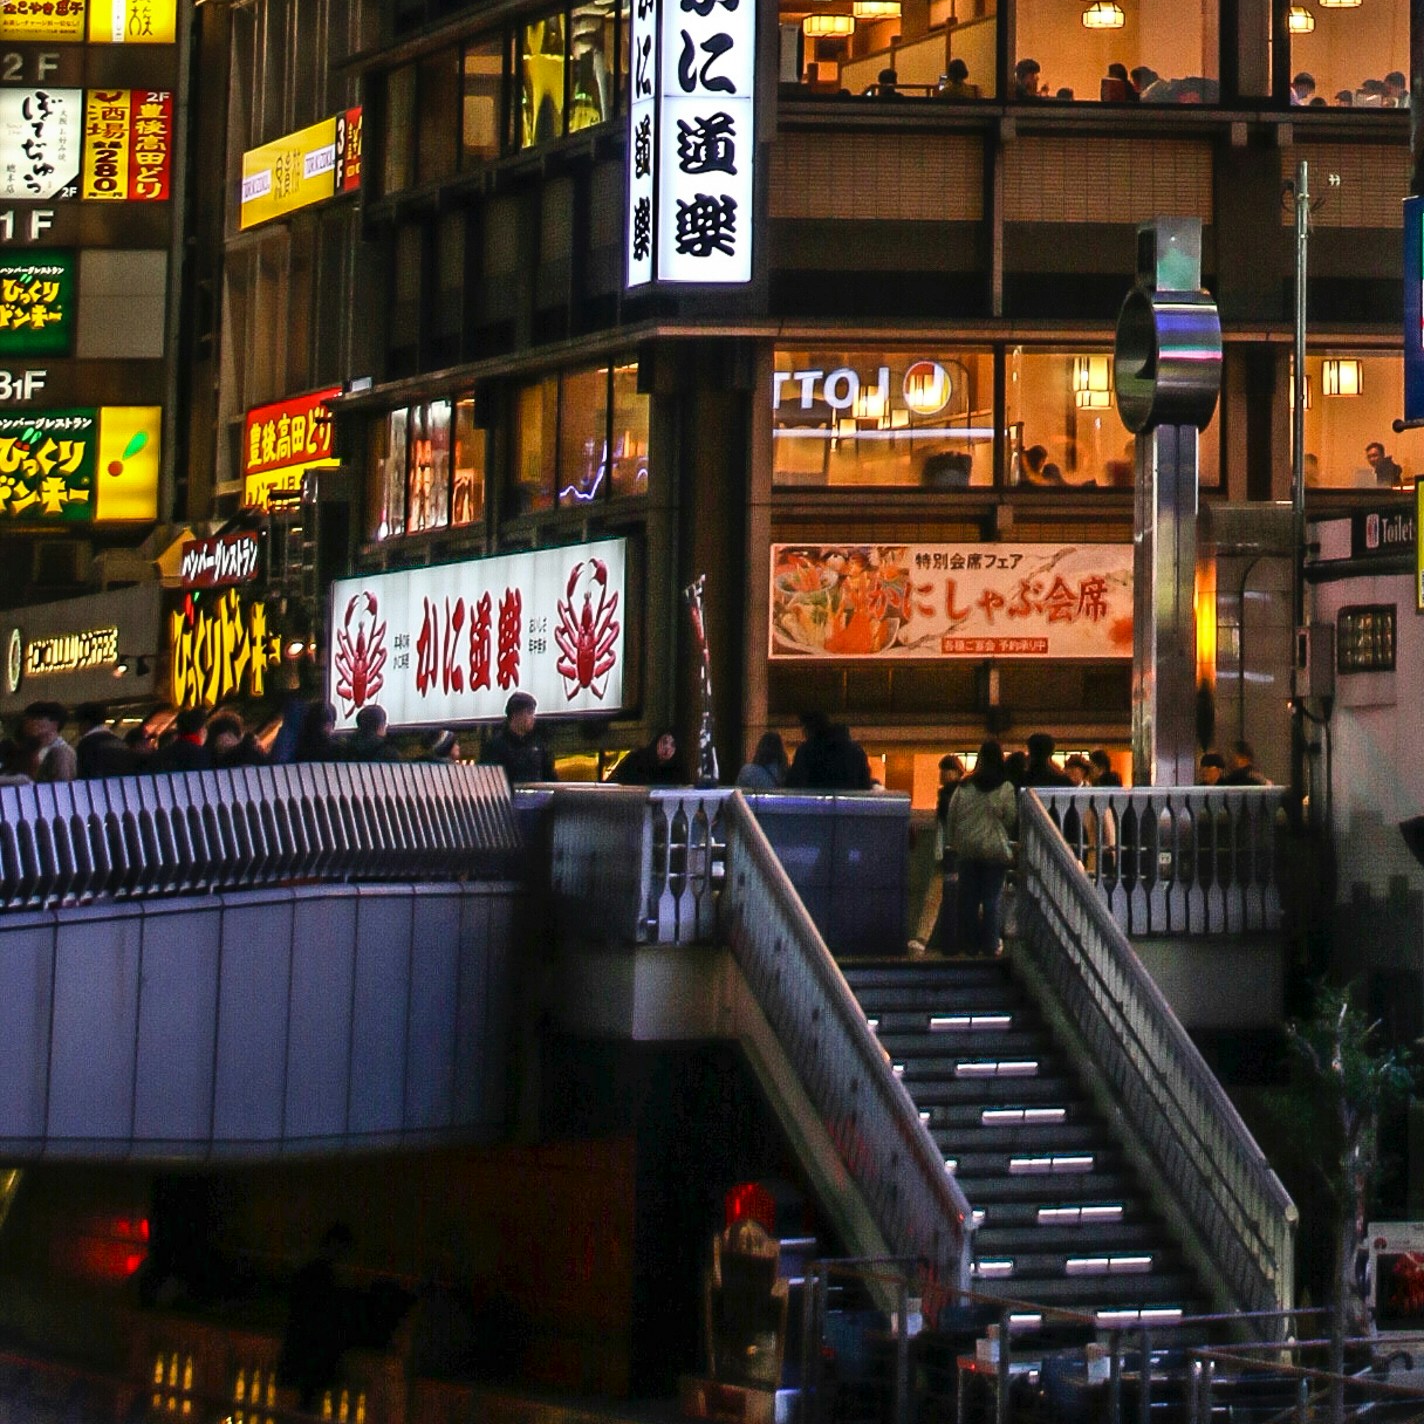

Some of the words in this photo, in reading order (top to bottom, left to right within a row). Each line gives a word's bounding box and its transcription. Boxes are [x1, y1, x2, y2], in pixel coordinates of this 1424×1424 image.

[146, 92, 171, 103] 2F
[87, 104, 129, 140] 酒場
[134, 102, 169, 199] 豊後高田どり
[93, 150, 119, 192] 280
[61, 187, 78, 199] 2F
[2, 278, 61, 304] びっくり
[181, 536, 259, 582] ハンバーグレストラン
[914, 552, 1024, 571] 特別会席フェア
[867, 574, 1110, 626] かにしゃぶ会席
[171, 586, 283, 708] びっくりドンキー
